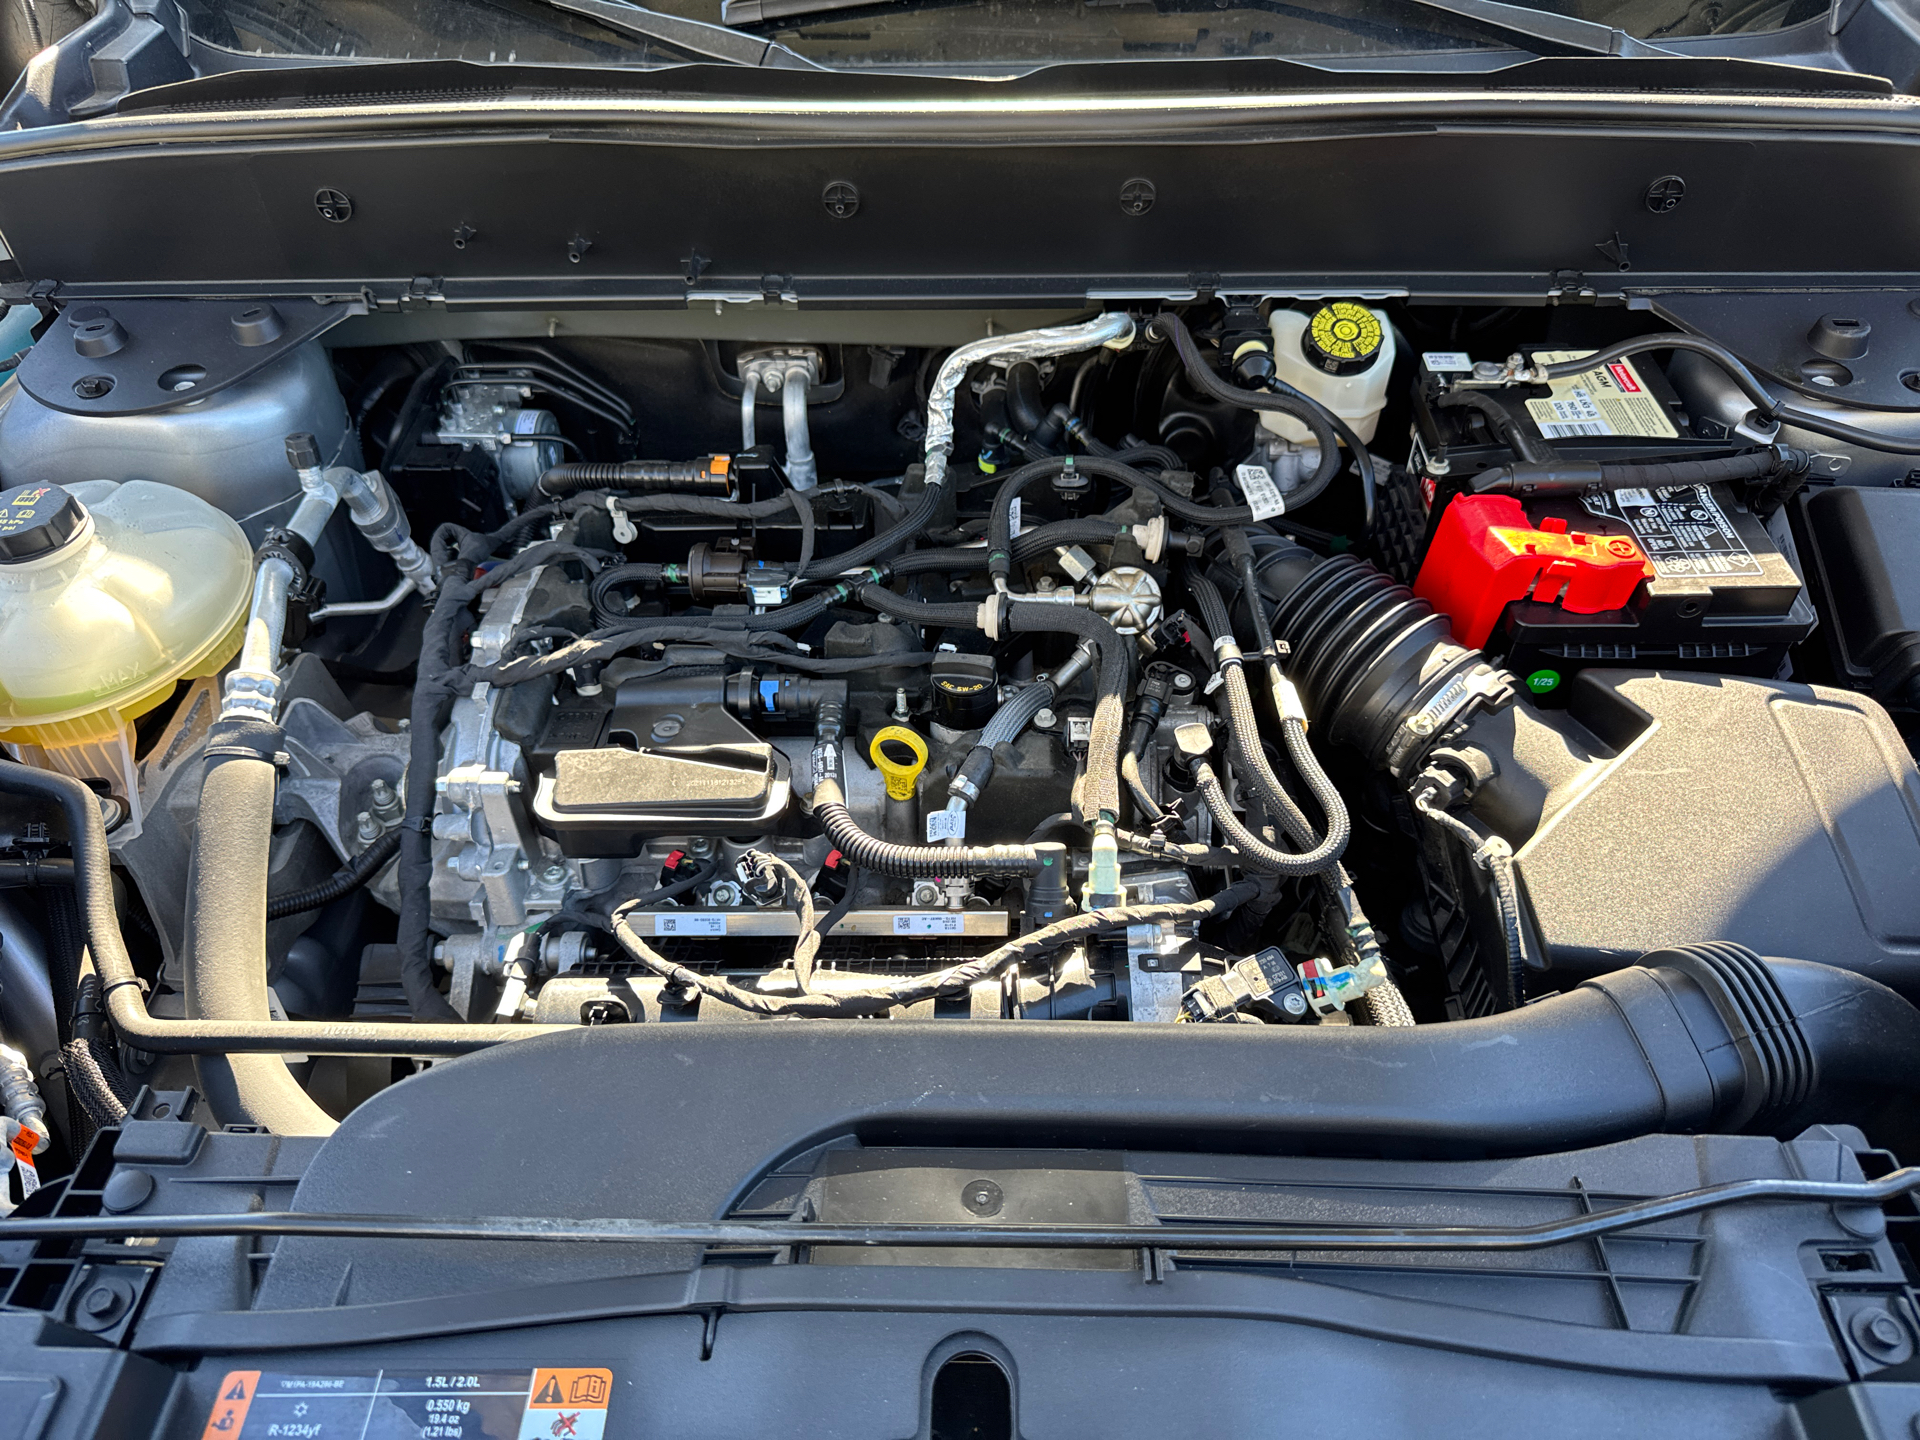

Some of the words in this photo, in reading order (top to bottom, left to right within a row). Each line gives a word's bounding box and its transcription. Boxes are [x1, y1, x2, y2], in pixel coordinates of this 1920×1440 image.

[1593, 370, 1612, 388] AGM
[100, 661, 146, 690] MAX
[941, 681, 955, 691] SAE
[957, 683, 984, 692] 5W-20
[1533, 678, 1554, 686] 1/25
[425, 1376, 449, 1388] 1.5L
[456, 1376, 481, 1388] 2.0L
[426, 1399, 455, 1412] 0.550
[456, 1400, 471, 1414] kg
[428, 1414, 447, 1424] 19.4
[448, 1416, 460, 1424] oz
[267, 1424, 323, 1439] R-1234yf
[422, 1426, 444, 1438] (1.21
[444, 1426, 463, 1438] lbs)
